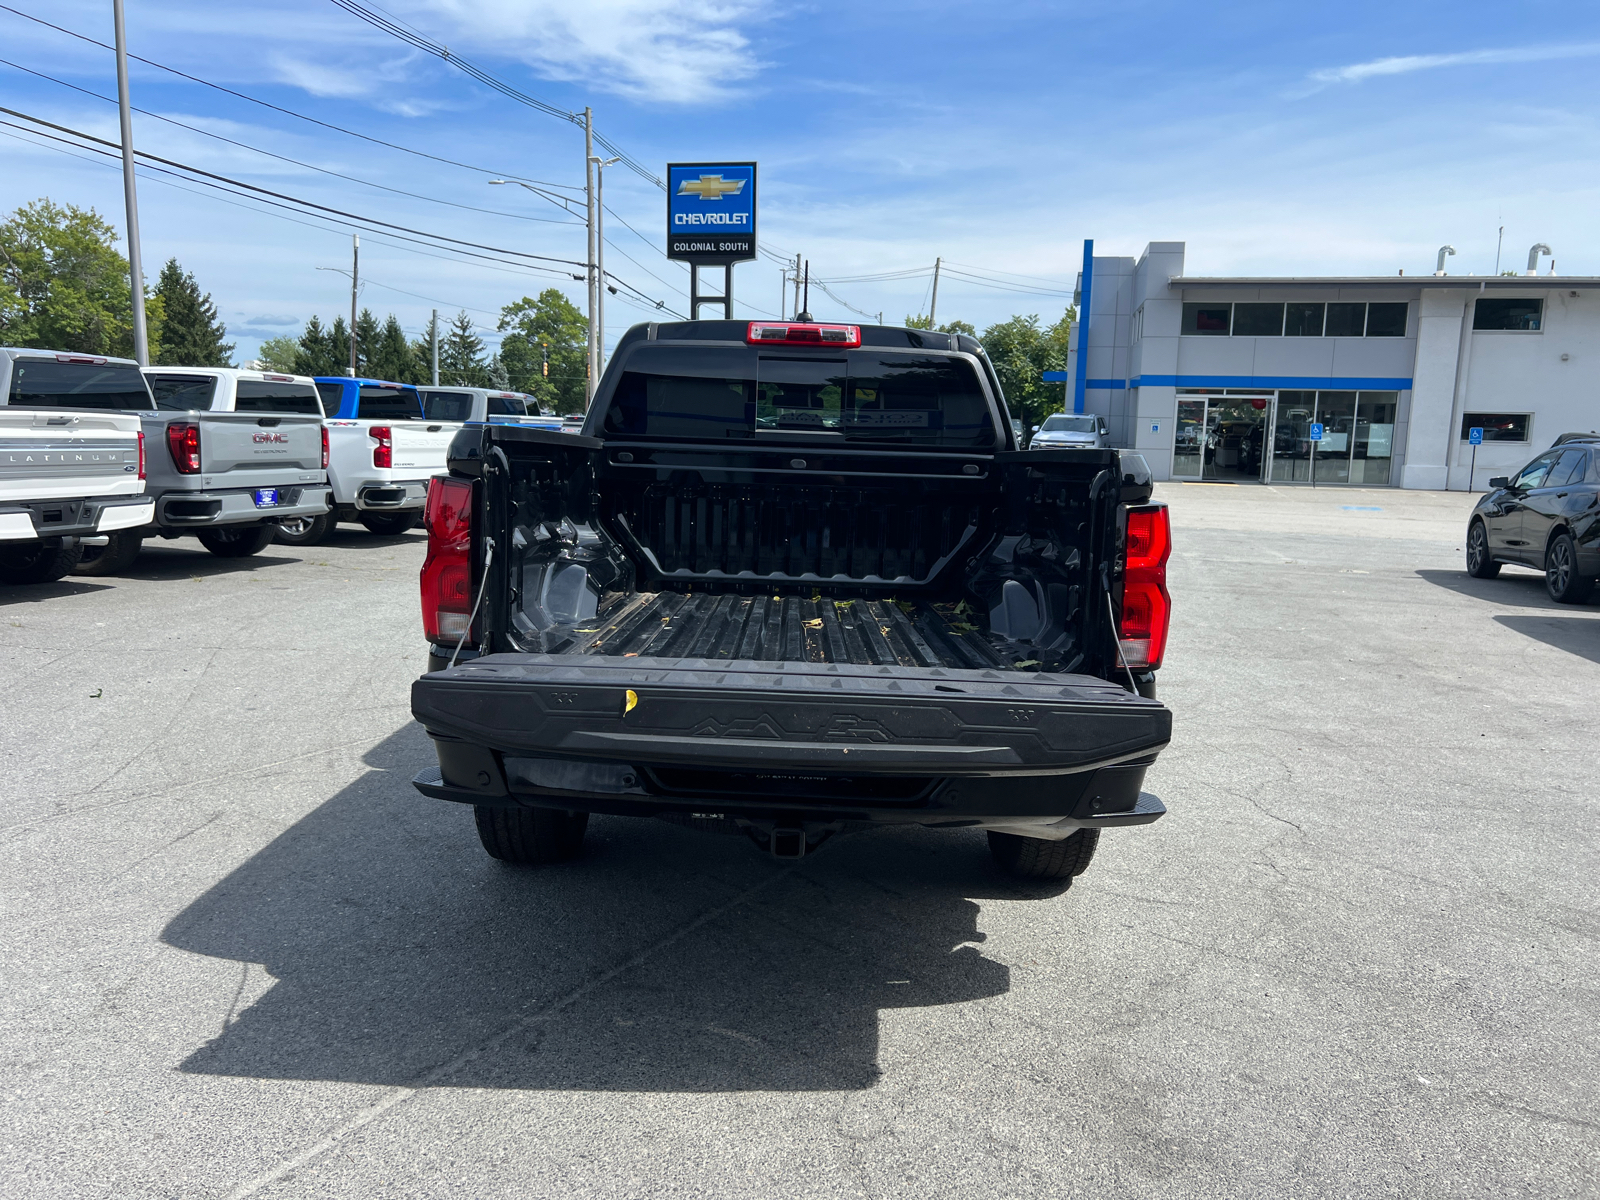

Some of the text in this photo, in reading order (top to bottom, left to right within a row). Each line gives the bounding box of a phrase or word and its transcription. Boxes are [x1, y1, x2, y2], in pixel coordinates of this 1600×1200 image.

[674, 213, 749, 225] CHEVROLET
[673, 242, 749, 252] COLONIAL SOUTH
[252, 432, 289, 444] GMC
